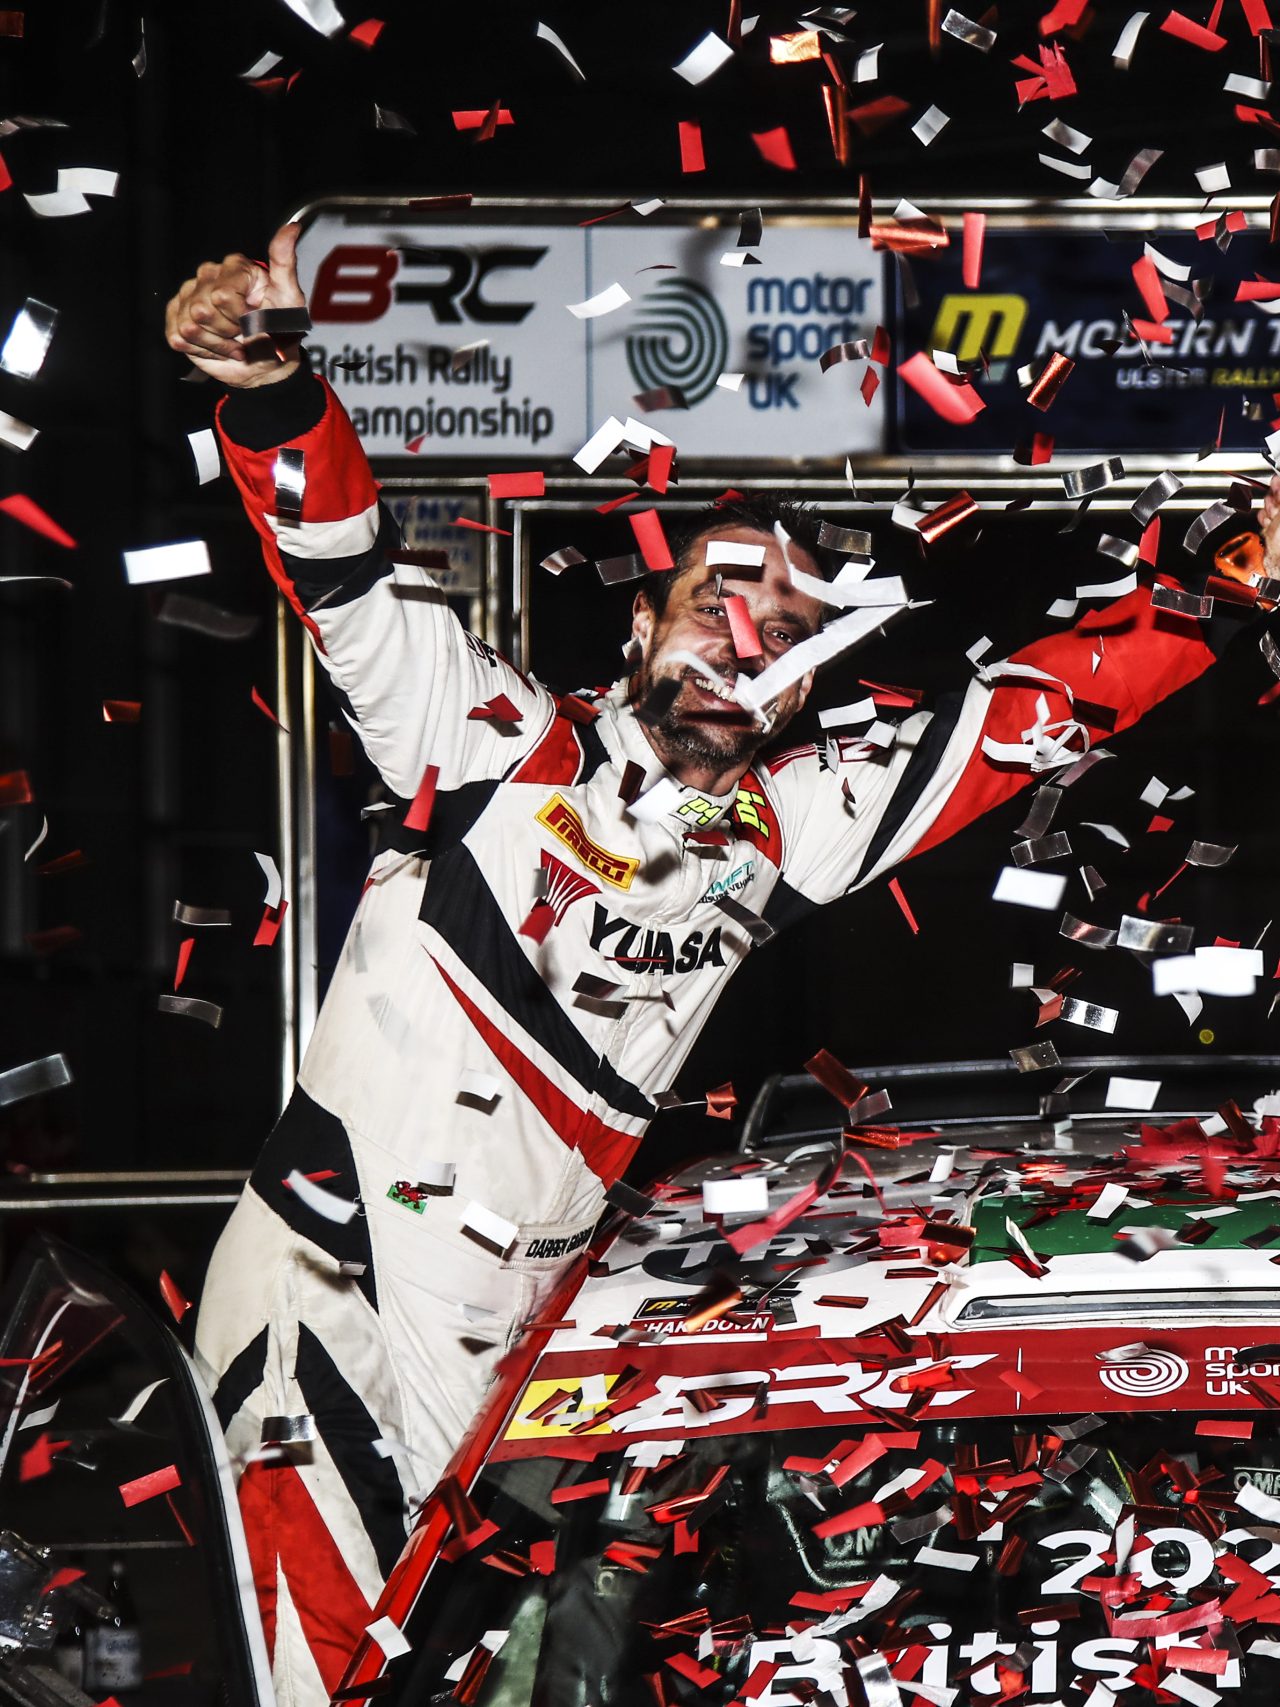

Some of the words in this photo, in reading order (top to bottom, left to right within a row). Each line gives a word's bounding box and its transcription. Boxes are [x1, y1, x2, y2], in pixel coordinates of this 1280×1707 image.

[308, 244, 550, 324] BRC
[746, 272, 874, 315] motor
[747, 318, 861, 369] sport
[428, 344, 512, 394] Rally
[747, 372, 801, 411] UK
[345, 397, 555, 445] ampionship
[545, 802, 632, 882] PIRELLI
[709, 861, 754, 894] WIFT
[590, 902, 727, 975] YUASA
[644, 1316, 769, 1335] HAKDON
[1206, 1380, 1251, 1396] UK
[824, 1524, 884, 1558] OM
[746, 1619, 1244, 1707] Bitis
